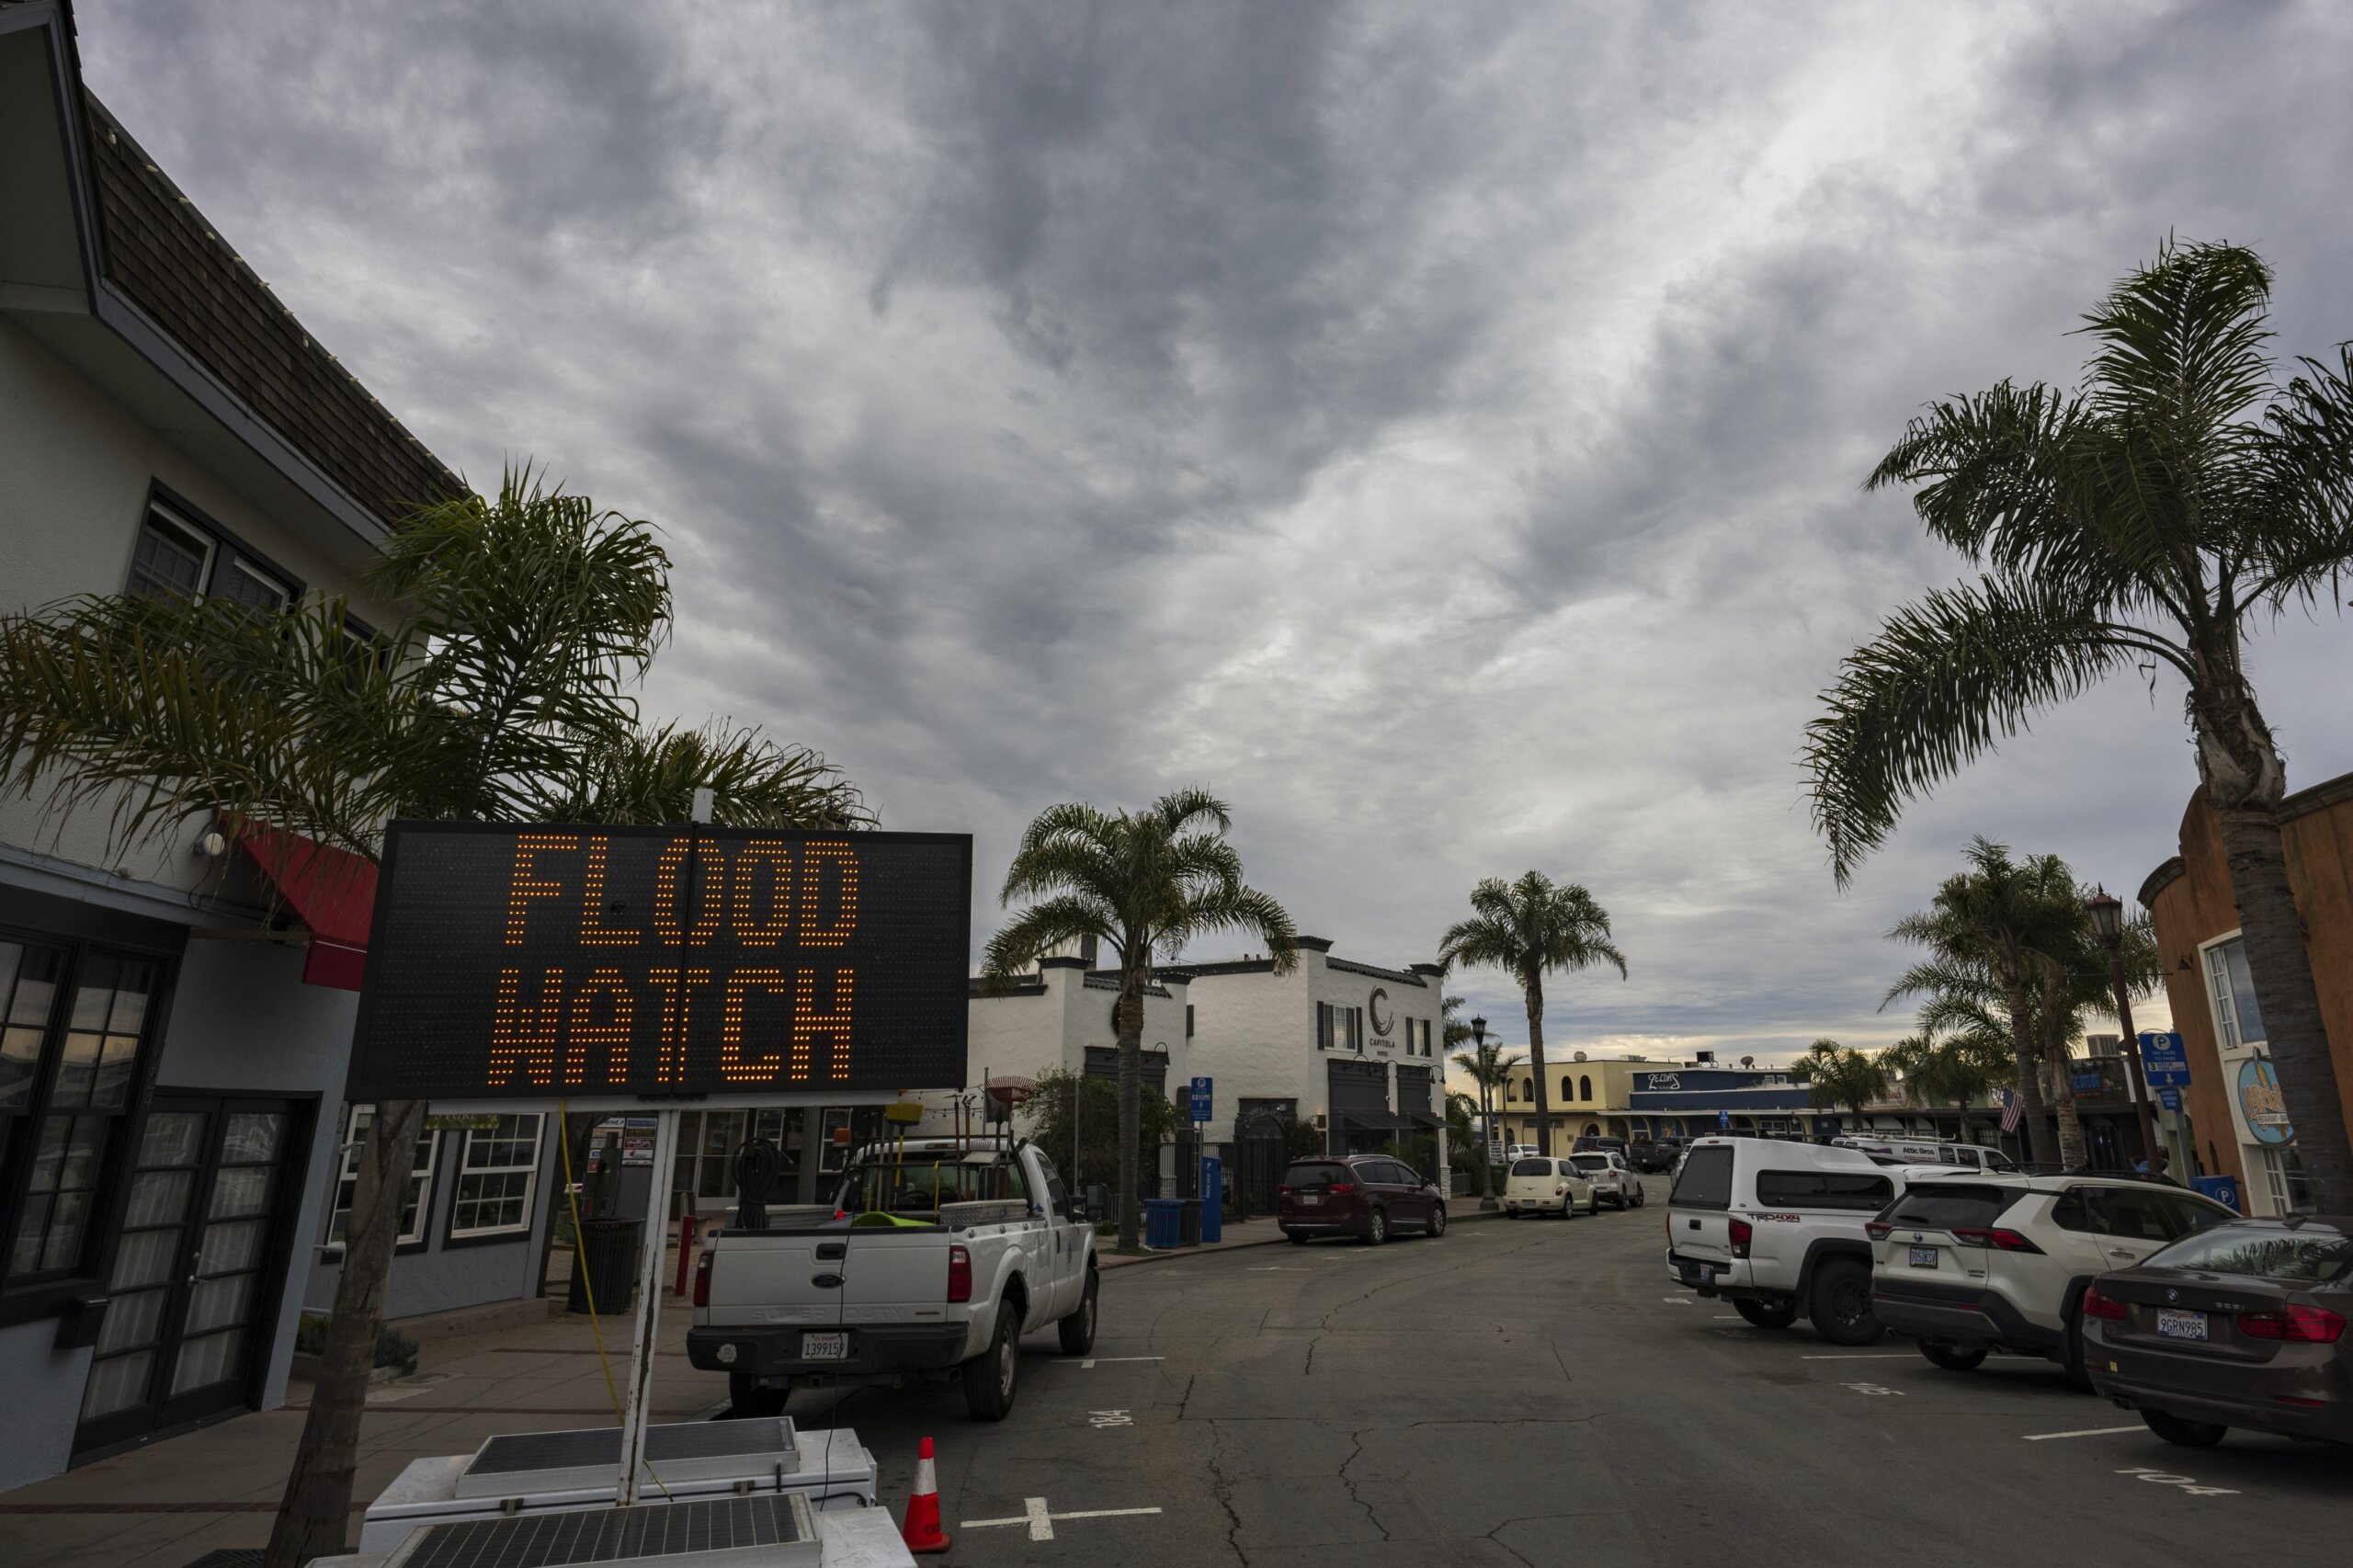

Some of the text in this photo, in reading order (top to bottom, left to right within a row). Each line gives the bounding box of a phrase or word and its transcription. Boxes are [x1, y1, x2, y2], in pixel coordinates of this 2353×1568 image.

[505, 834, 859, 947] FLOOD
[487, 968, 856, 1085] WATCH
[1370, 1038, 1394, 1048] CAPITOLA
[2150, 1062, 2156, 1071] 3
[750, 1307, 904, 1321] SUPER DUTY
[2161, 1318, 2203, 1335] 9GRN985
[804, 1343, 845, 1355] 1399159
[2113, 1467, 2244, 1496] 104
